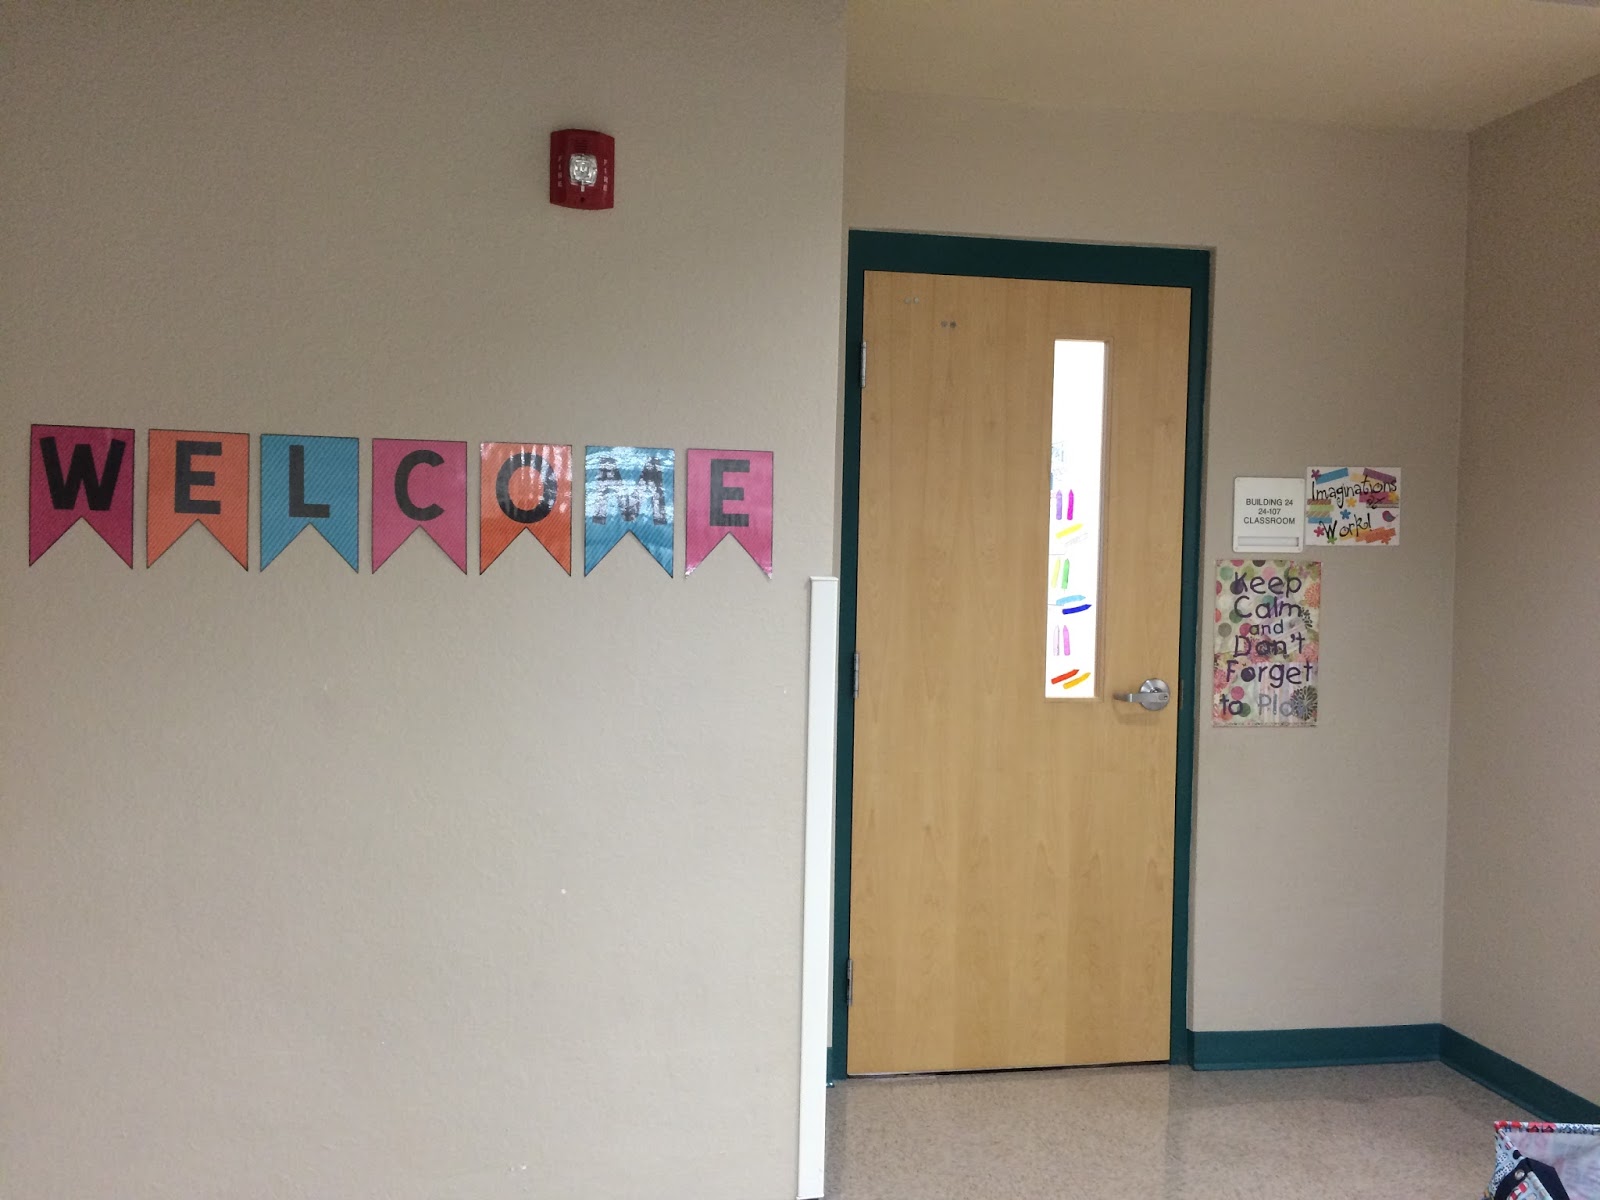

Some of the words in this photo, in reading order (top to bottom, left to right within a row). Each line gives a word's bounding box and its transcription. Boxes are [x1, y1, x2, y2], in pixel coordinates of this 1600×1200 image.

[41, 436, 751, 527] WELCOME
[1311, 476, 1397, 508] Imaginations
[1245, 498, 1282, 506] BUILDING
[1284, 498, 1294, 506] 24
[1243, 516, 1296, 525] CLASSROOM
[1319, 513, 1372, 539] Work!
[1233, 571, 1302, 598] Keep
[1233, 595, 1302, 619] Calm
[1249, 619, 1284, 636] and
[1232, 632, 1306, 658] Don't
[1226, 660, 1314, 688] Forget
[1220, 693, 1243, 716] to
